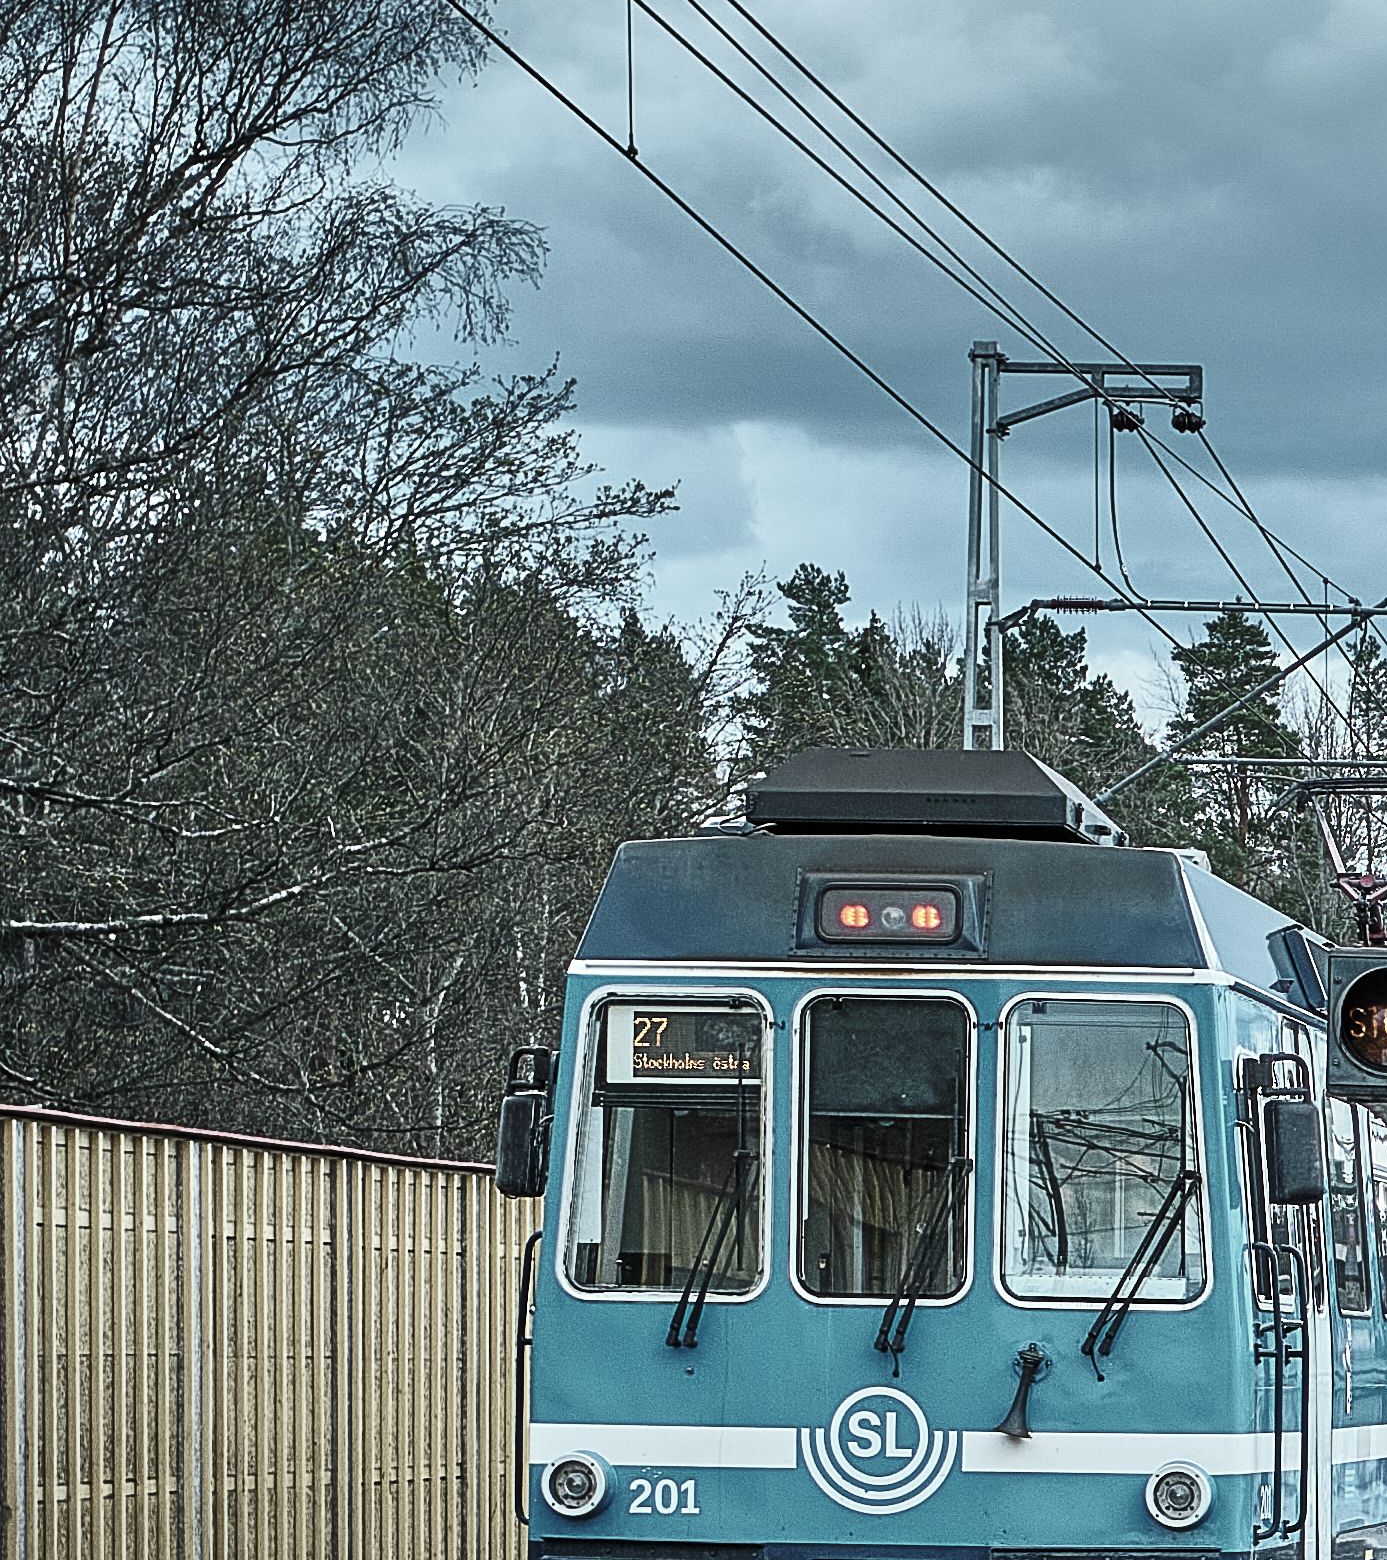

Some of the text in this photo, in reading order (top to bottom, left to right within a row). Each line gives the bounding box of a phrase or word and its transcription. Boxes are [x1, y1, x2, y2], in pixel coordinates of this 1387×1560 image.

[634, 1017, 668, 1047] 27
[713, 1054, 750, 1070] östra
[847, 1410, 913, 1458] SL
[629, 1478, 700, 1515] 201
[1260, 1484, 1272, 1520] 201
